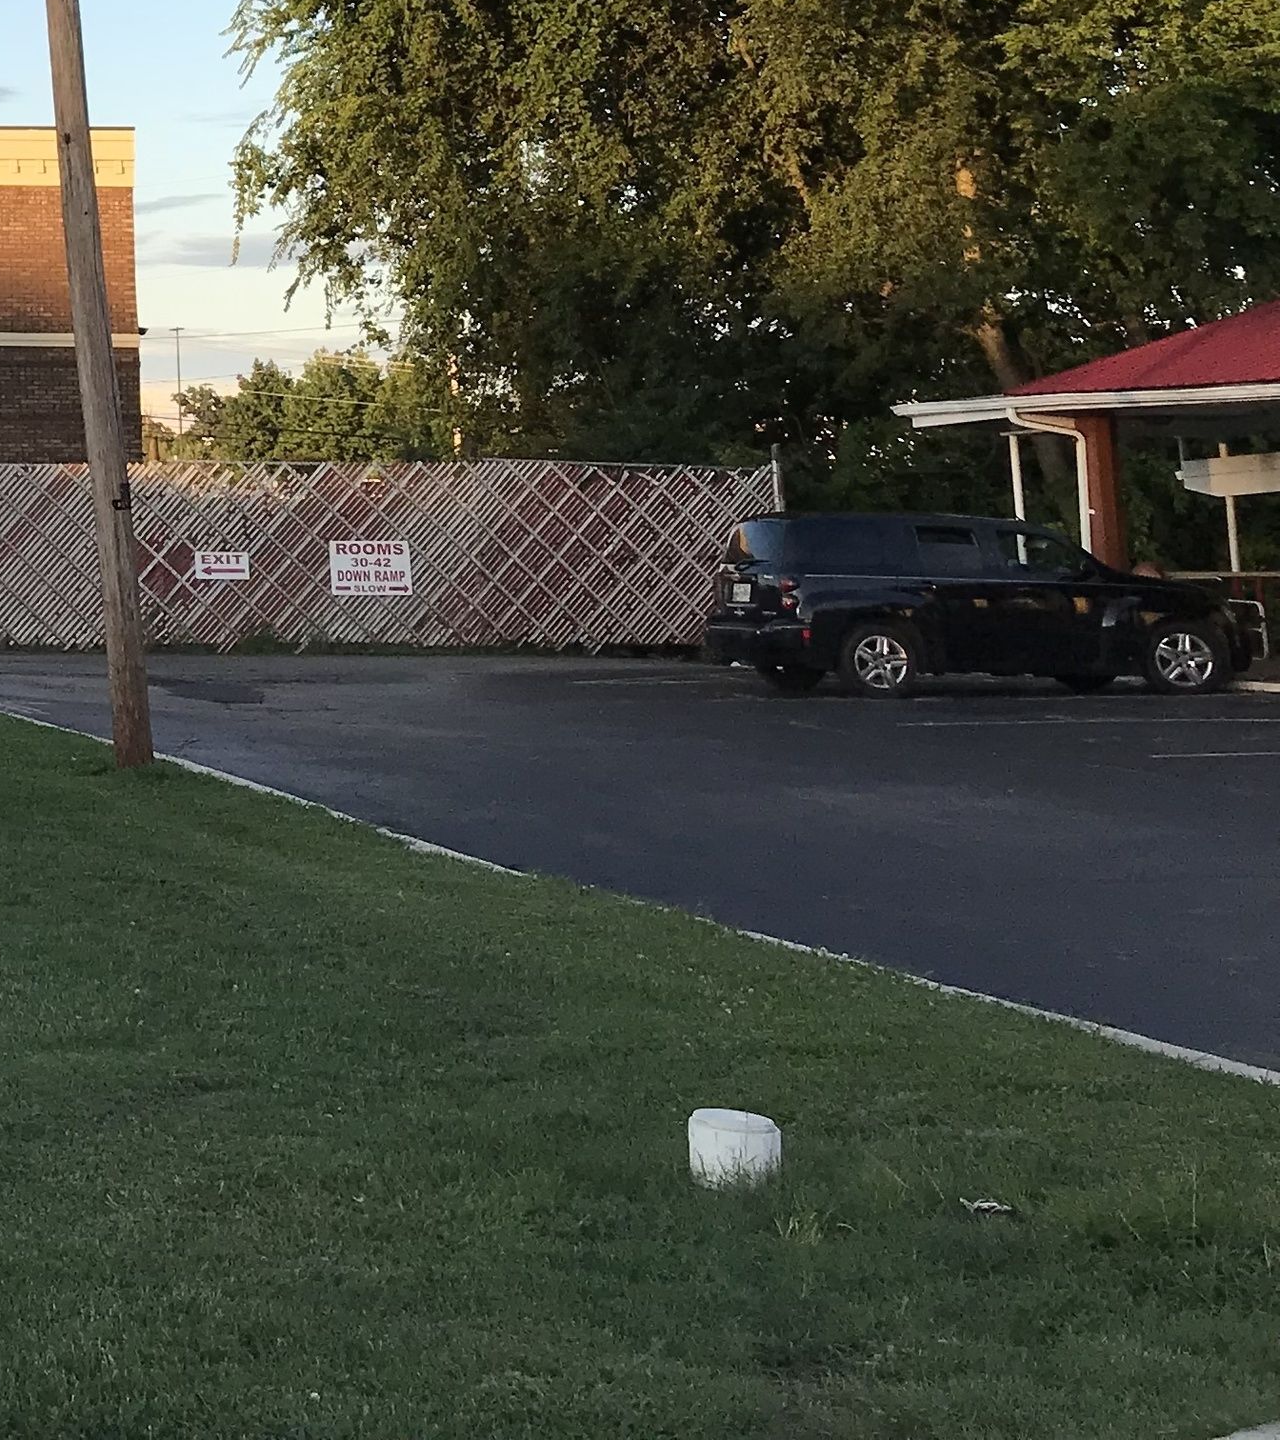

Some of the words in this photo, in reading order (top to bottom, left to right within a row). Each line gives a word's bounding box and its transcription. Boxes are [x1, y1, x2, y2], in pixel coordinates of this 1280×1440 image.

[335, 543, 405, 556] ROOMS
[201, 554, 244, 565] EXIT
[350, 557, 392, 568] 30-42
[337, 570, 371, 583] DOWN
[373, 570, 406, 583] RAMP
[353, 584, 388, 593] SLOW
